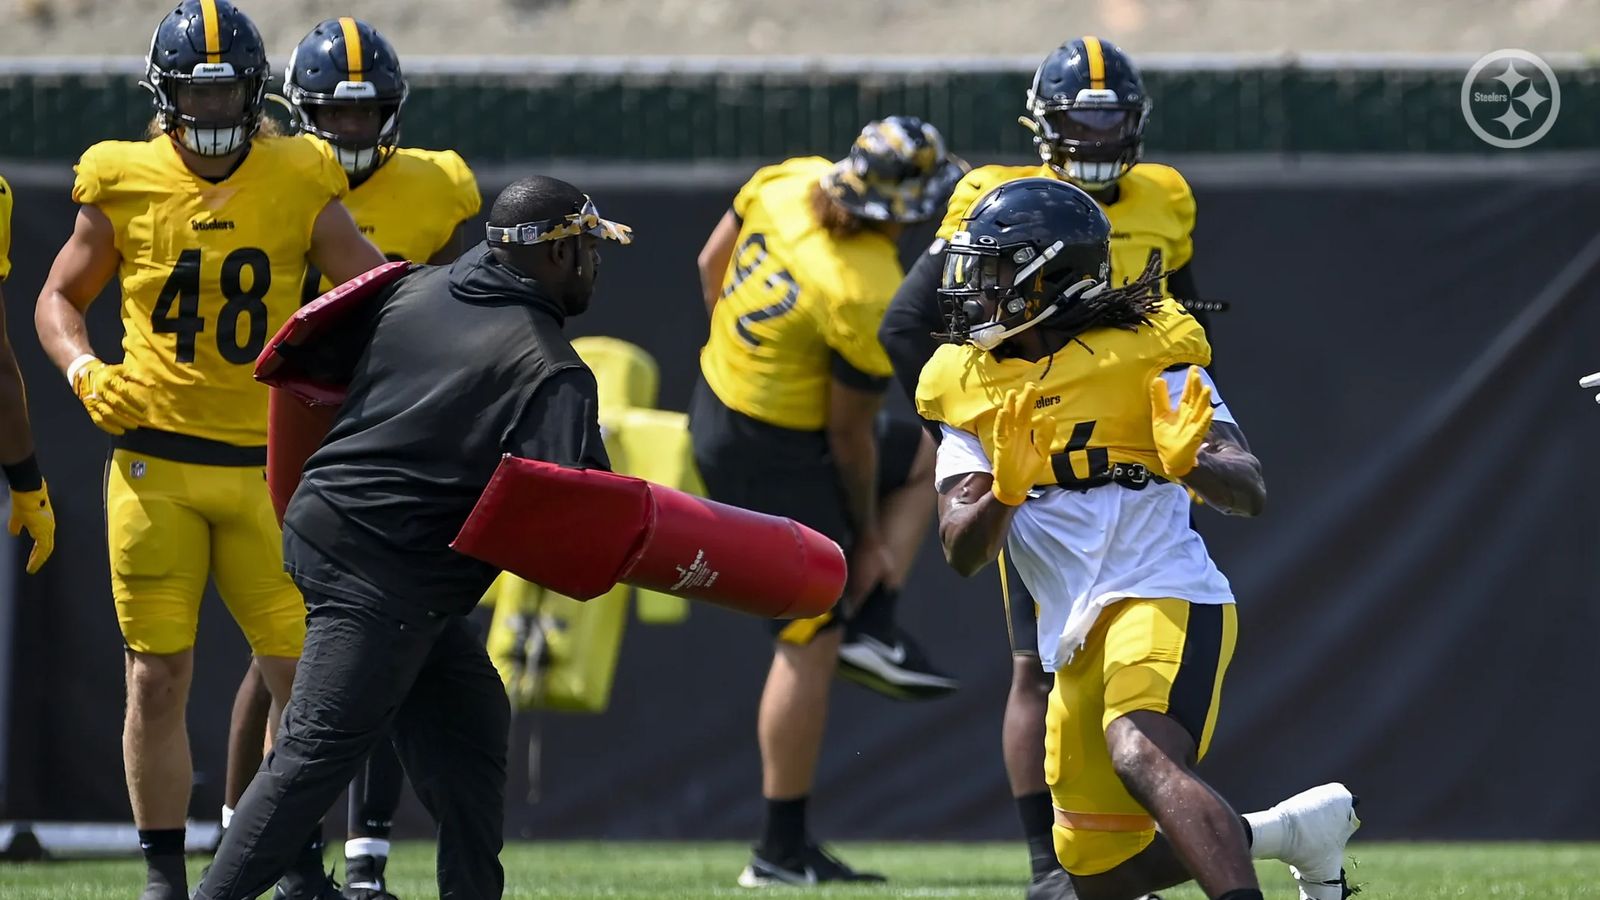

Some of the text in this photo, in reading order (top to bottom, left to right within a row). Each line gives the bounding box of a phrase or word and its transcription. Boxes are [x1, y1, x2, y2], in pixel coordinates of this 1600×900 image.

[191, 219, 235, 231] Steelers
[151, 247, 272, 365] 48
[722, 232, 801, 347] 92
[1033, 395, 1061, 410] elers
[1050, 420, 1109, 491] 6
